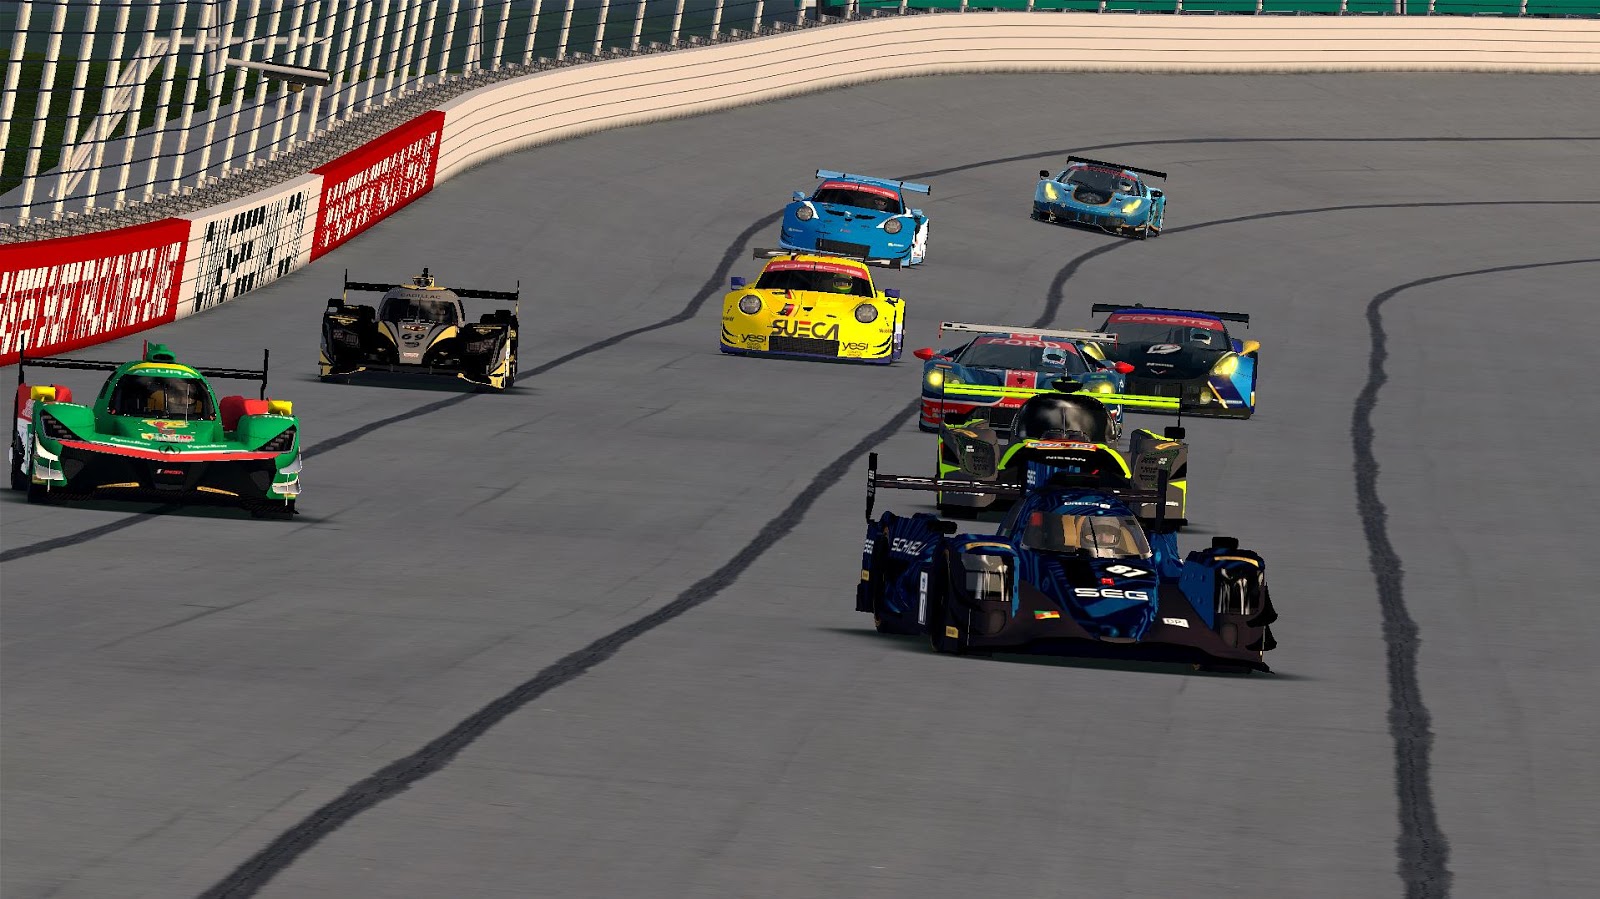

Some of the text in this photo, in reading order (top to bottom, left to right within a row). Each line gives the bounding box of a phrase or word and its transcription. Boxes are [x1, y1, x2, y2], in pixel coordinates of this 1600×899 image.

[770, 263, 863, 276] PORSCHE
[1117, 315, 1214, 326] CORVETTE
[771, 320, 840, 340] SUECA
[401, 333, 426, 341] 69
[987, 338, 1062, 349] FORD
[133, 369, 195, 378] ACURA
[1073, 587, 1149, 601] SEG
